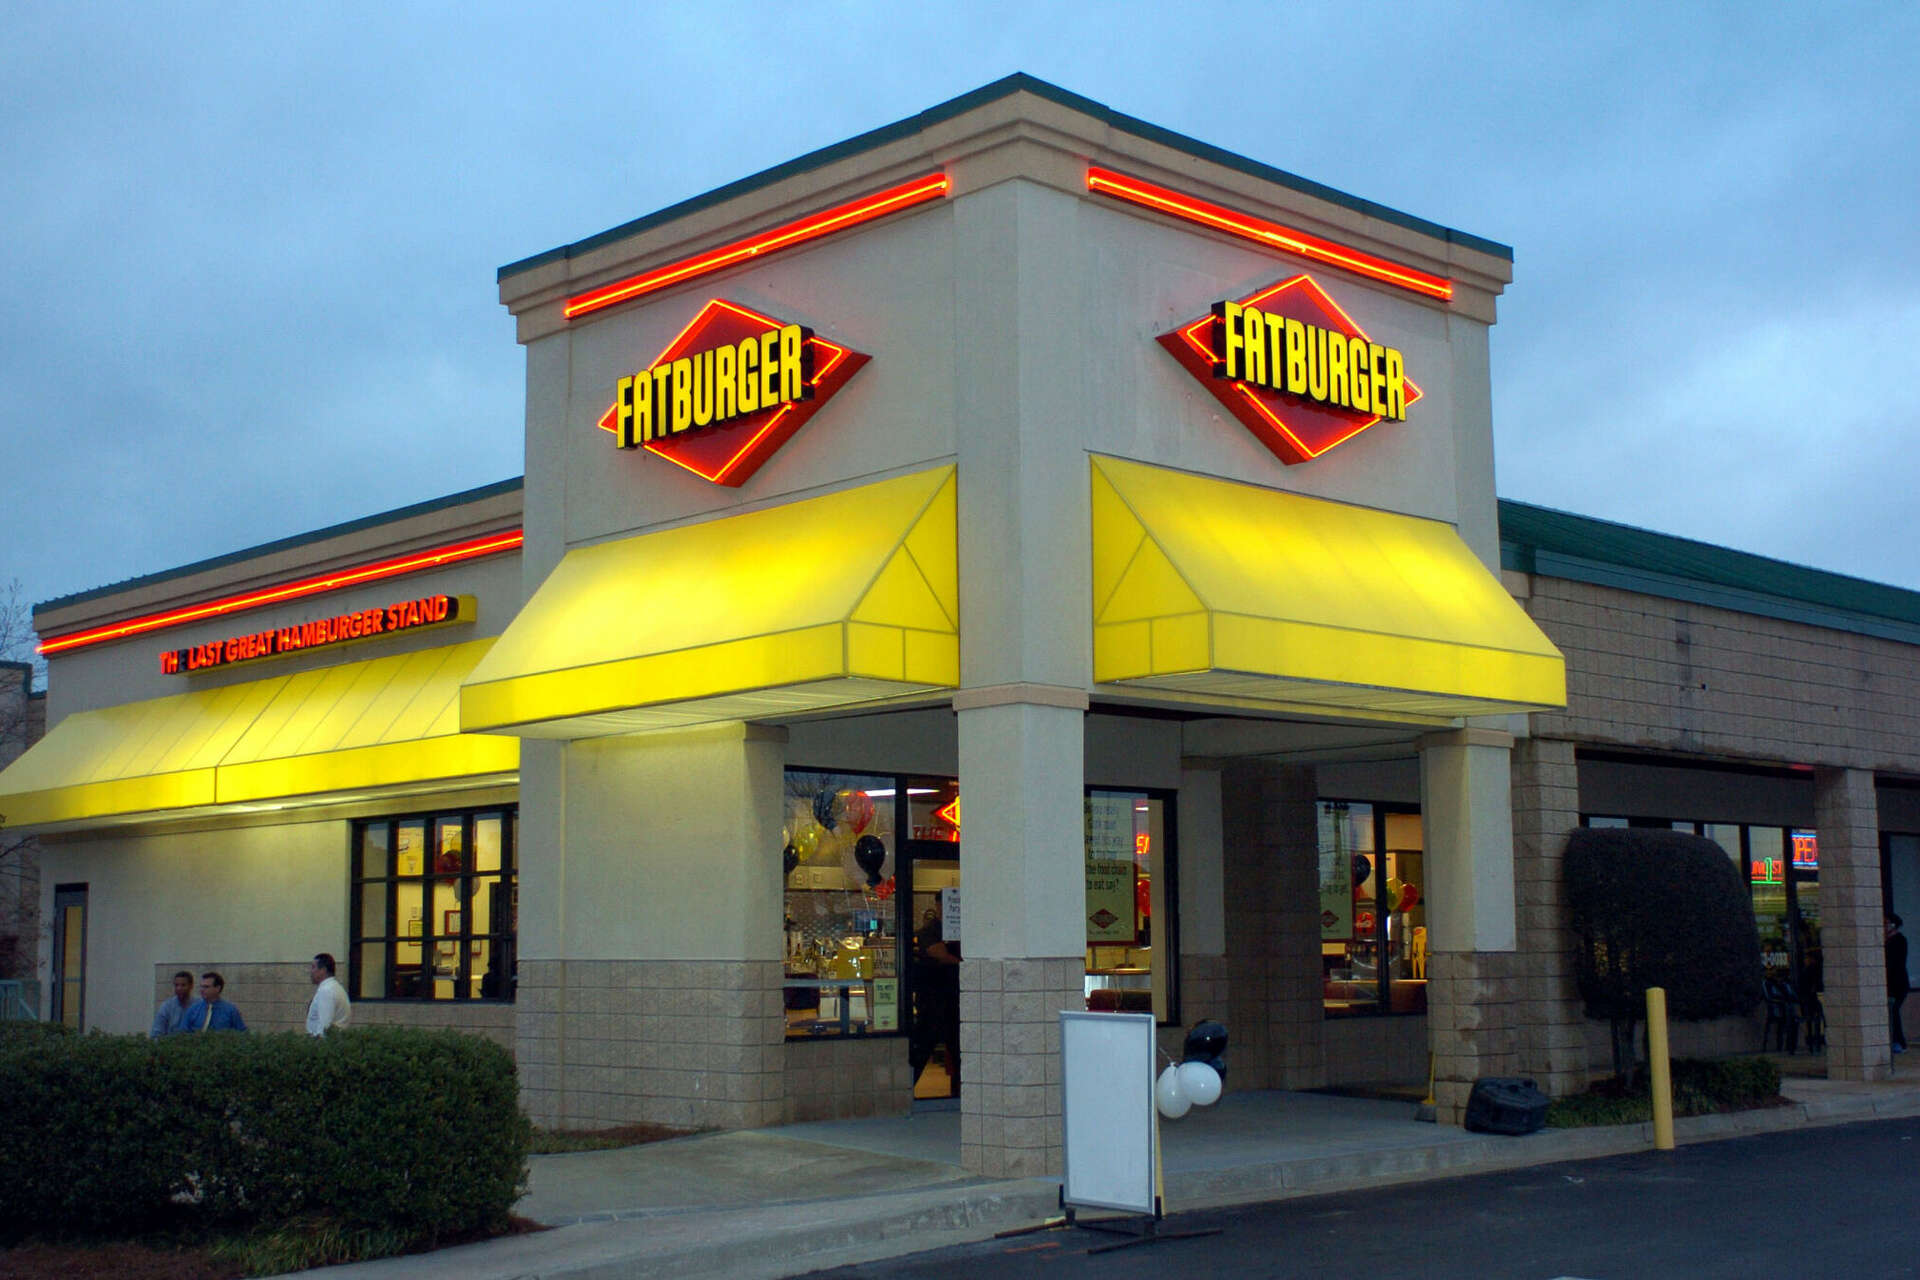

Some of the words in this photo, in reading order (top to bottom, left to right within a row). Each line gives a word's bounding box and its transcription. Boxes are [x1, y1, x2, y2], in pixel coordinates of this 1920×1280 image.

[616, 323, 803, 450] FATBURGER
[1224, 300, 1407, 422] FATBURGER
[188, 640, 223, 670] LAST
[225, 629, 275, 661] GREAT
[277, 608, 384, 652] HAMBURGER
[387, 594, 450, 631] STAND
